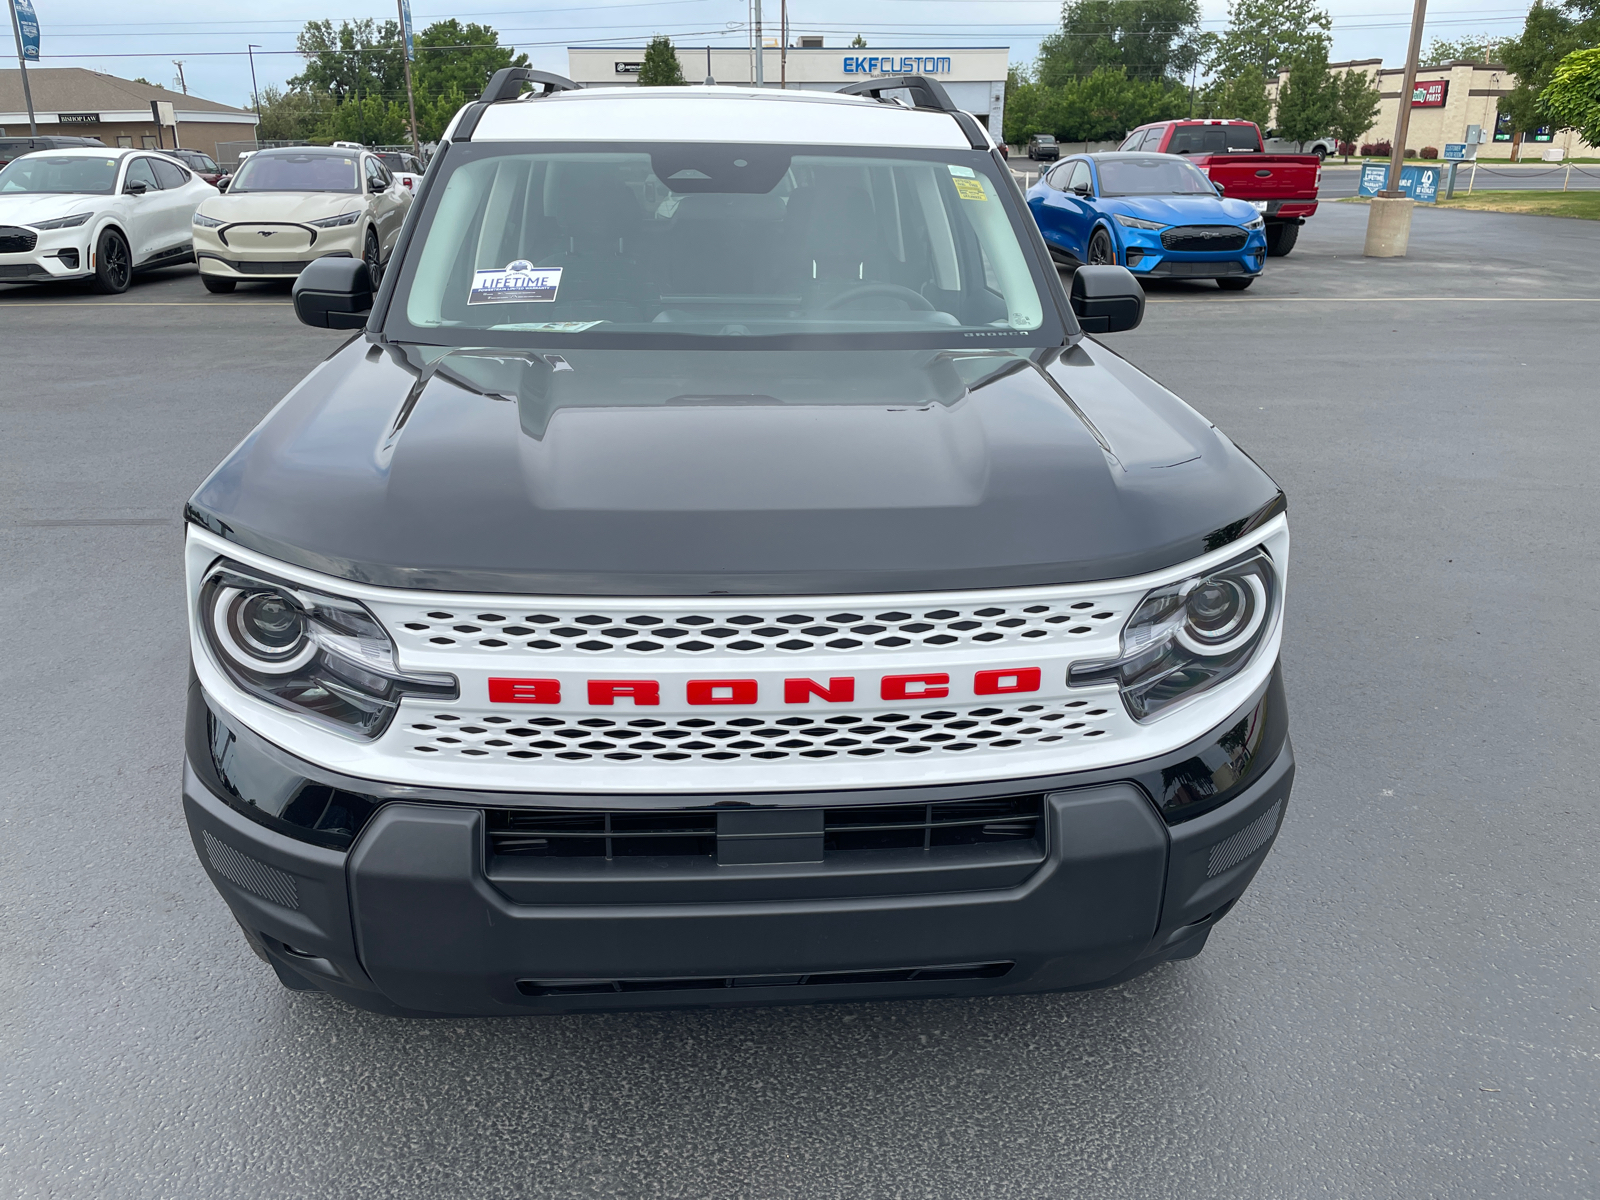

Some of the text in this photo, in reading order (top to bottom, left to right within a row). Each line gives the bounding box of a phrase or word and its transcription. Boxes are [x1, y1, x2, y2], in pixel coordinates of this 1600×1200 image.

[1428, 85, 1442, 94] AUTO
[1426, 94, 1441, 102] PARTS
[482, 276, 549, 289] LIFETIME
[488, 667, 1041, 706] BRONCO
